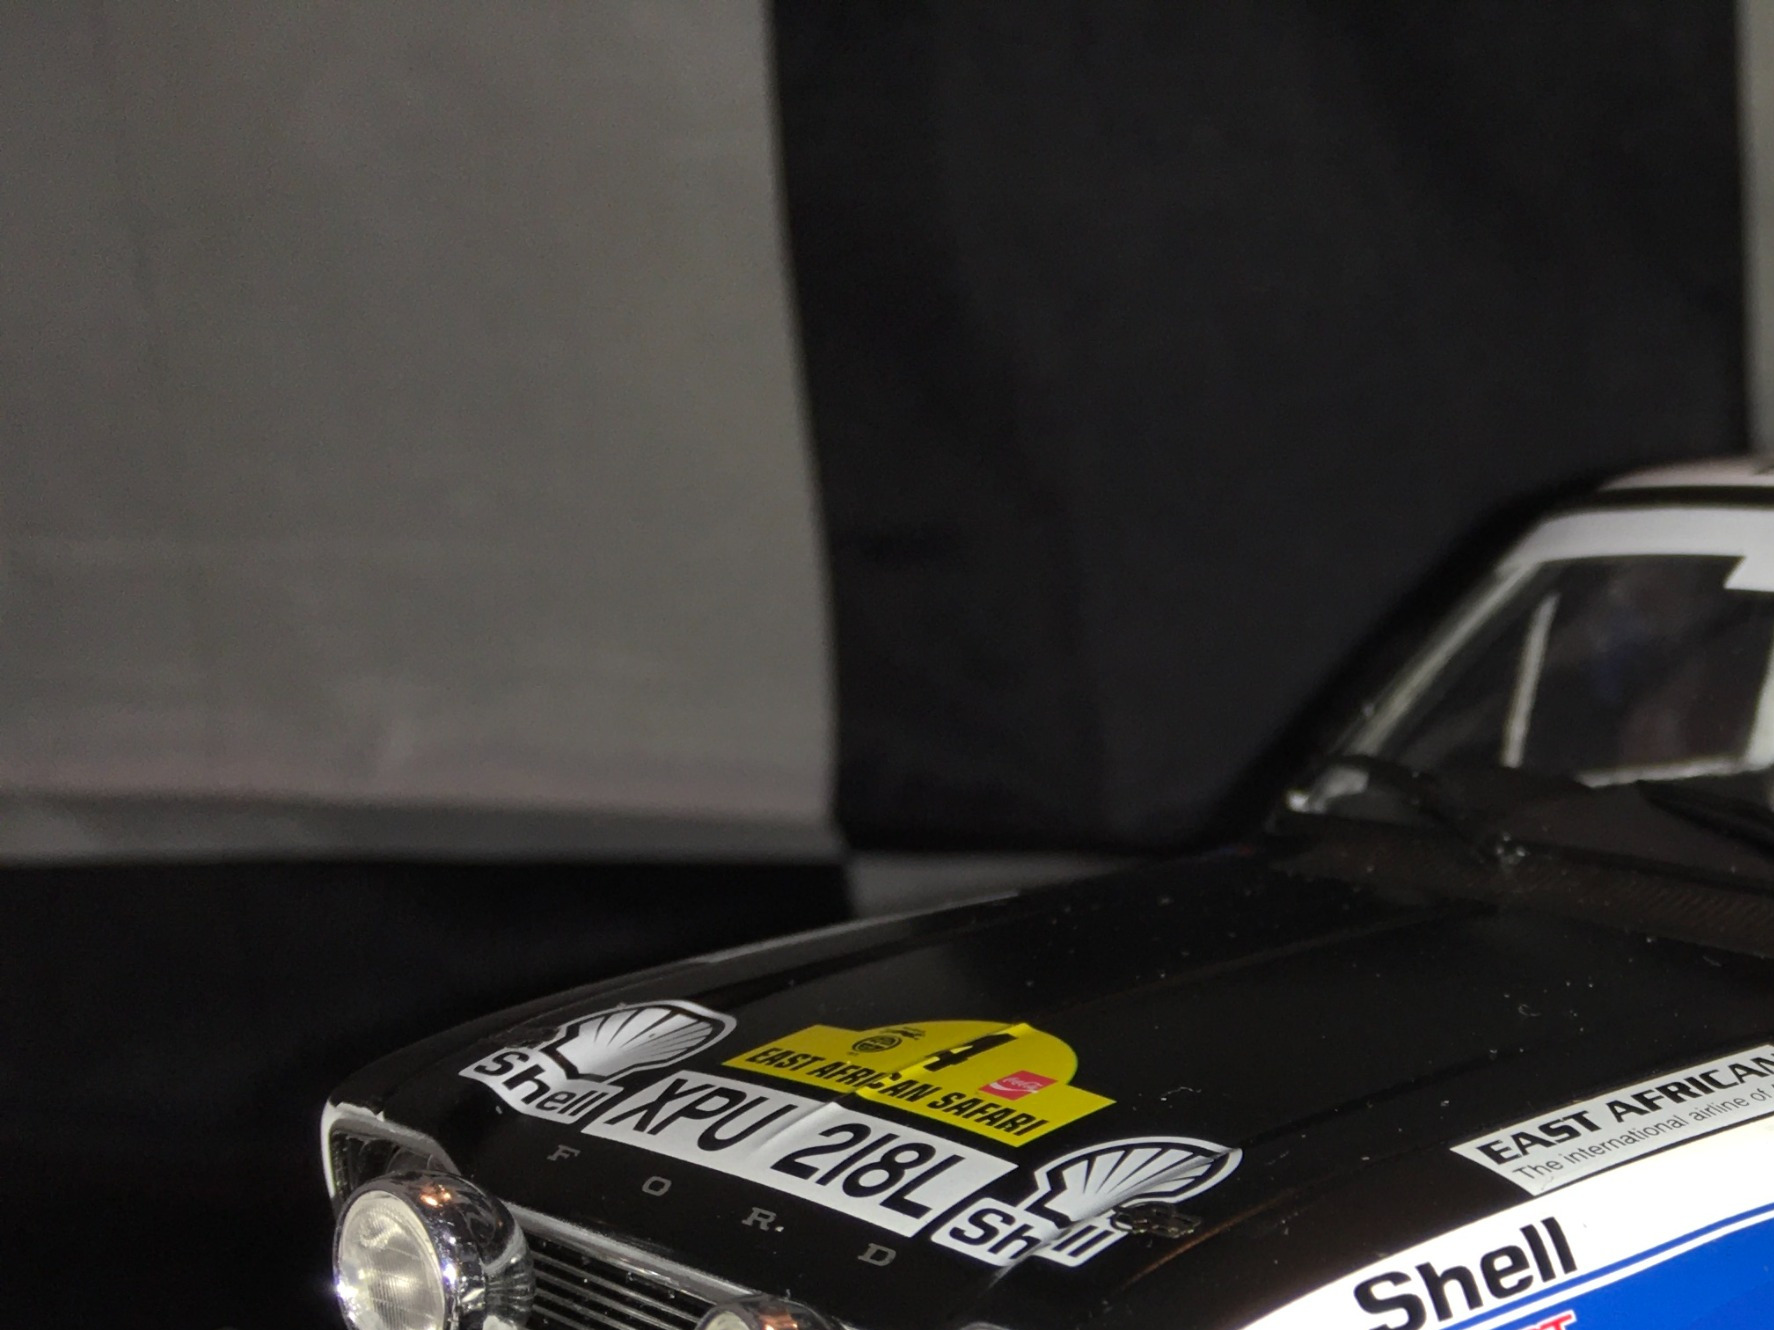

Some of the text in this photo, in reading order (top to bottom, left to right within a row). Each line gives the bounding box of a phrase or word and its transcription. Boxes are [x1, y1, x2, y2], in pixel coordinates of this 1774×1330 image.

[474, 1050, 610, 1118] Shell
[745, 1047, 1050, 1137] EAST AFRICAN SAFARI
[603, 1078, 967, 1220] XPU 218L
[1477, 1110, 1603, 1165] EAST
[1512, 1154, 1565, 1182] The
[1565, 1114, 1689, 1166] international
[1692, 1095, 1751, 1123] airline
[547, 1144, 897, 1267] FORD
[949, 1207, 1116, 1260] Shll
